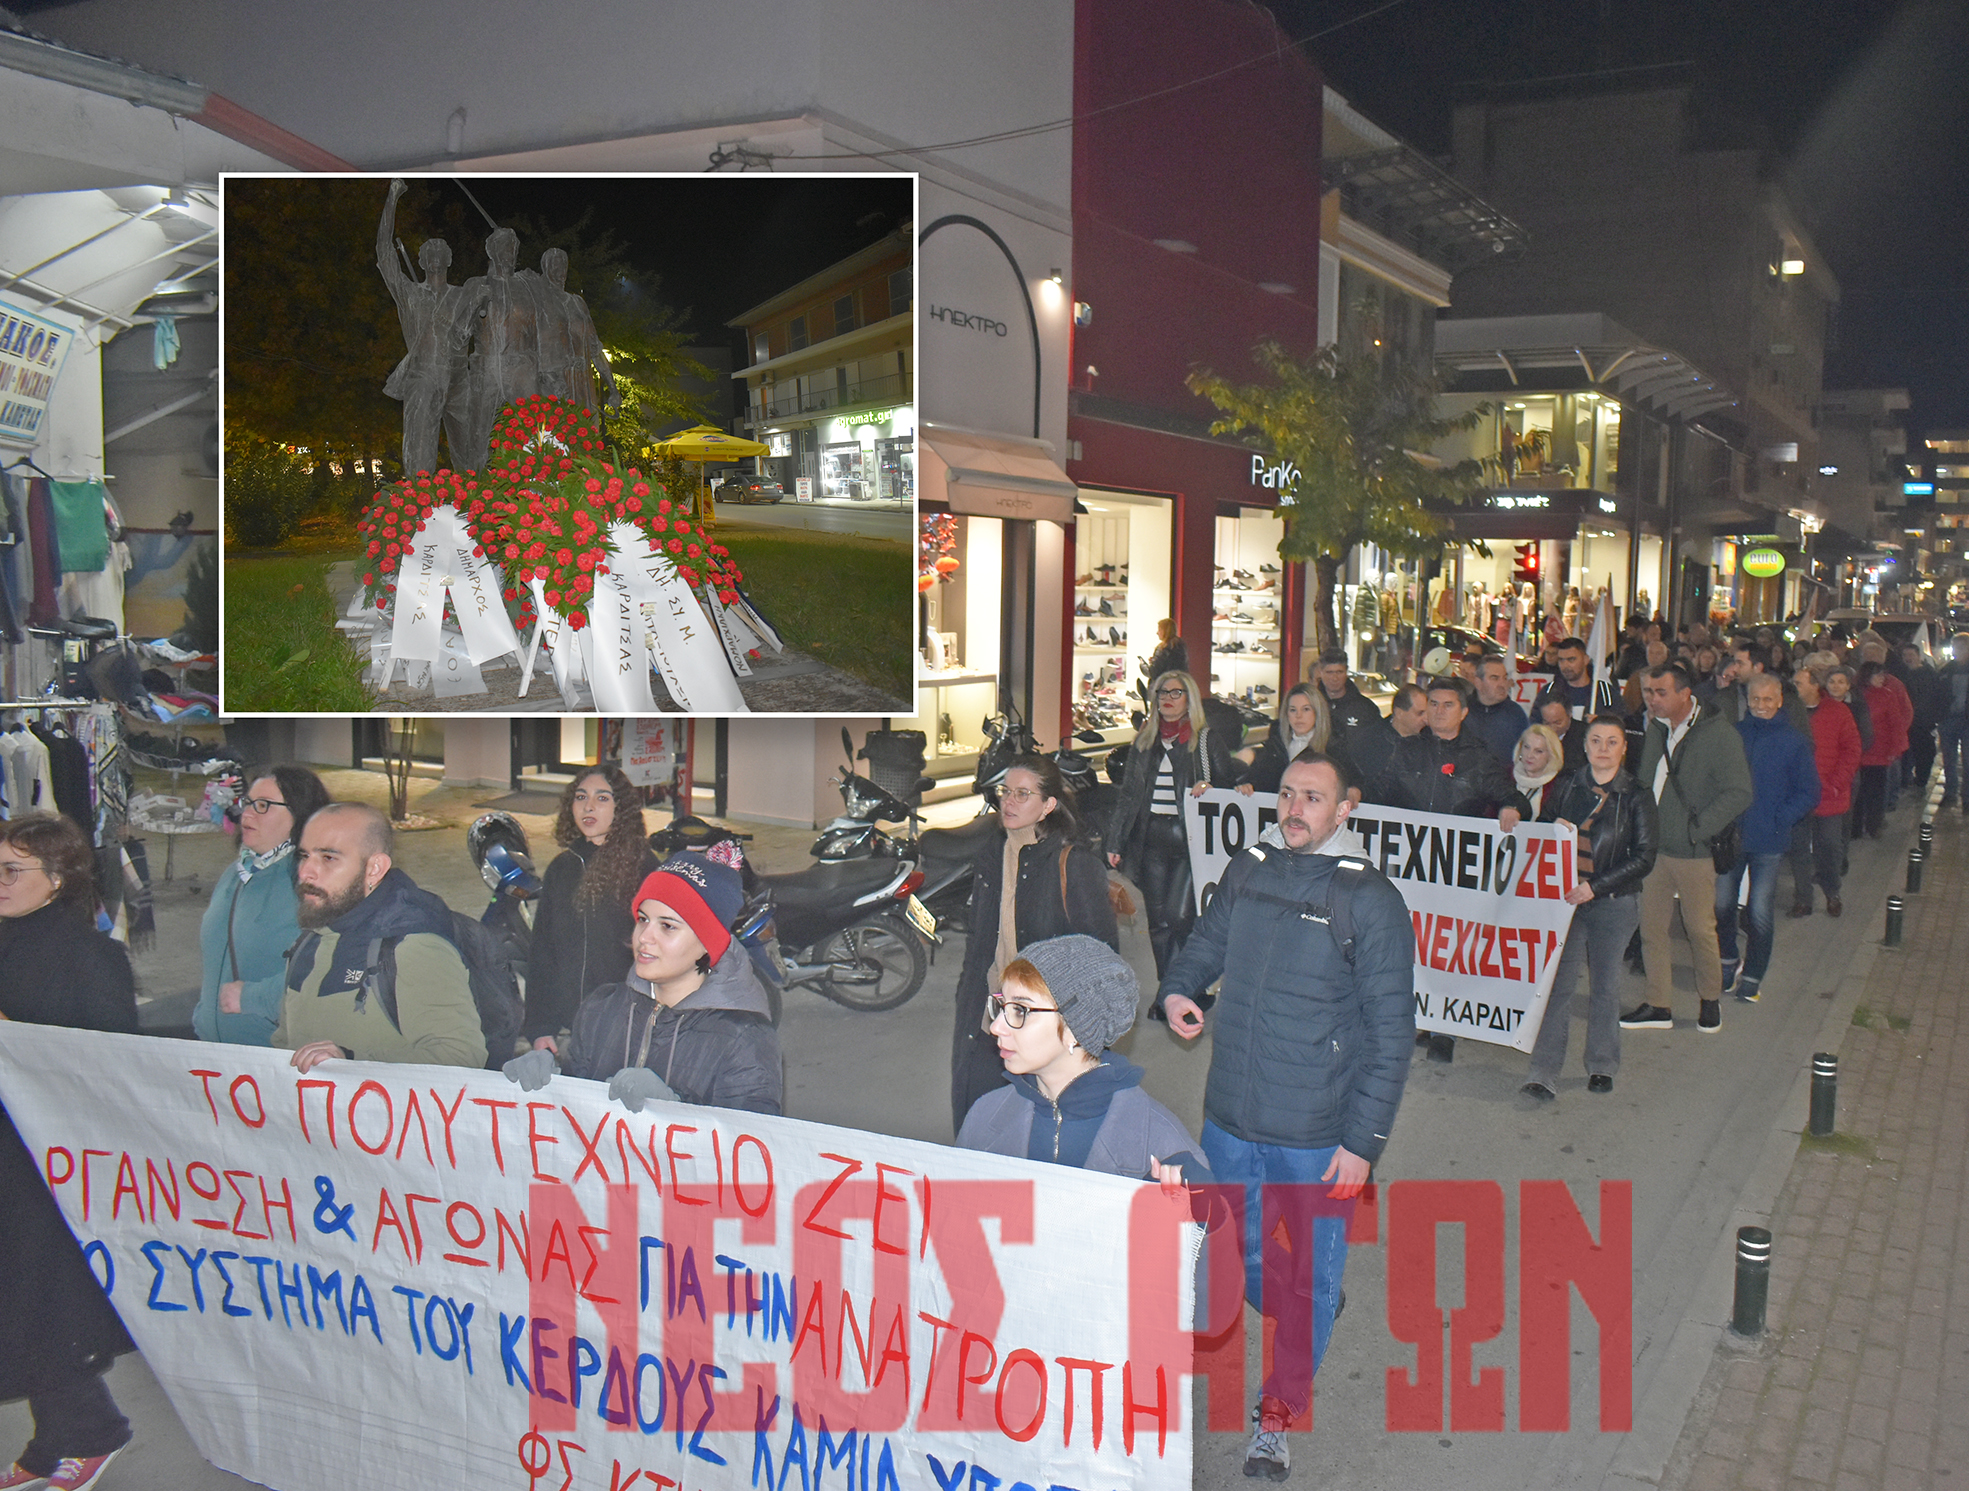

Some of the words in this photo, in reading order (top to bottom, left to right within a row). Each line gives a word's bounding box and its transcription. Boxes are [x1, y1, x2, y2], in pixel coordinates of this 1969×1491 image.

[456, 547, 489, 618] ΔΗΜΑΡΧΟΣ
[611, 572, 633, 676] ΚΑΡΔΙΤΣΑΣ
[1198, 801, 1246, 858] ΤΟ
[1515, 838, 1573, 901] ΖΕΙ
[1443, 997, 1525, 1032] ΚΑΡΔΙΤ
[189, 1069, 265, 1128] ΤΟ
[296, 1079, 774, 1218] ΠΟΛΥΤΕΧΝΕΙΟ
[803, 1152, 932, 1260] ΖΕΙ
[47, 1146, 297, 1243] ΡΓΑΝΩΣΗ
[313, 1175, 356, 1243] &
[372, 1187, 621, 1305] ΑΓΩΝΑΣ
[638, 1236, 706, 1323] ΓΙΑ
[714, 1254, 797, 1343] ΤΗΝ
[791, 1279, 1168, 1459] ΑΝΑΤΡΟΠΗ
[140, 1240, 383, 1344] ΣΥΣΤΗΜΑ
[392, 1285, 475, 1375] ΤΟΥ
[499, 1312, 728, 1466] ΚΕΡΔΟΥΣ
